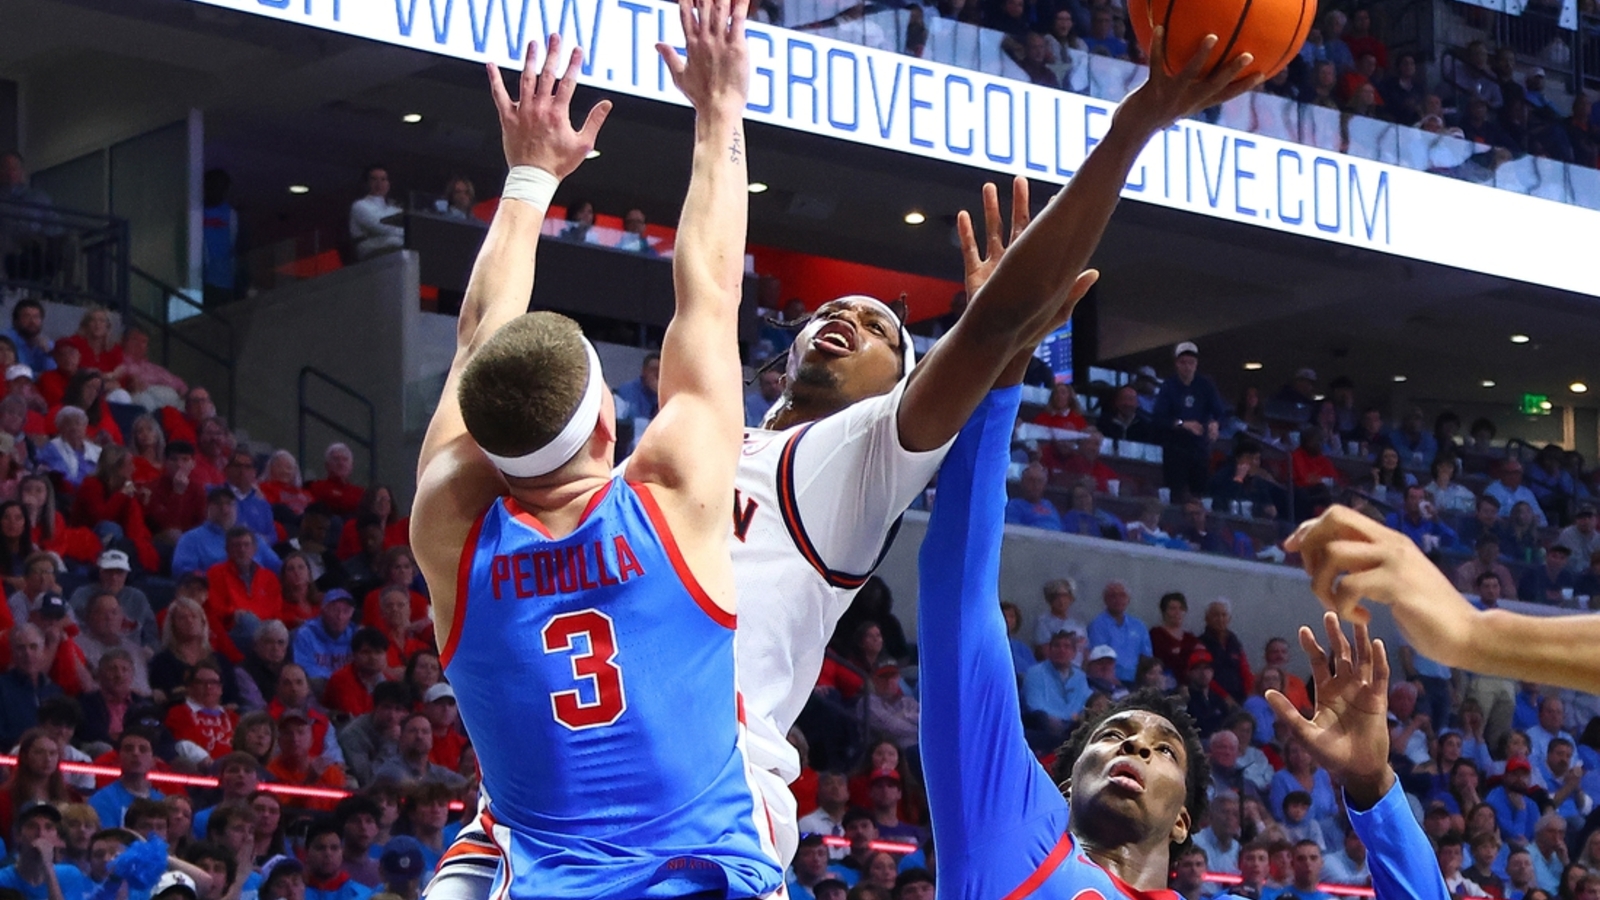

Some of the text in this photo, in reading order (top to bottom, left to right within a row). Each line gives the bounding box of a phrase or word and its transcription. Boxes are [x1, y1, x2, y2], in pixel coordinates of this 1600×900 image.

[395, 0, 1390, 245] WWW.THGROVECOLLETIVE.COM
[492, 535, 645, 600] PEDULLA
[541, 608, 627, 731] 3
